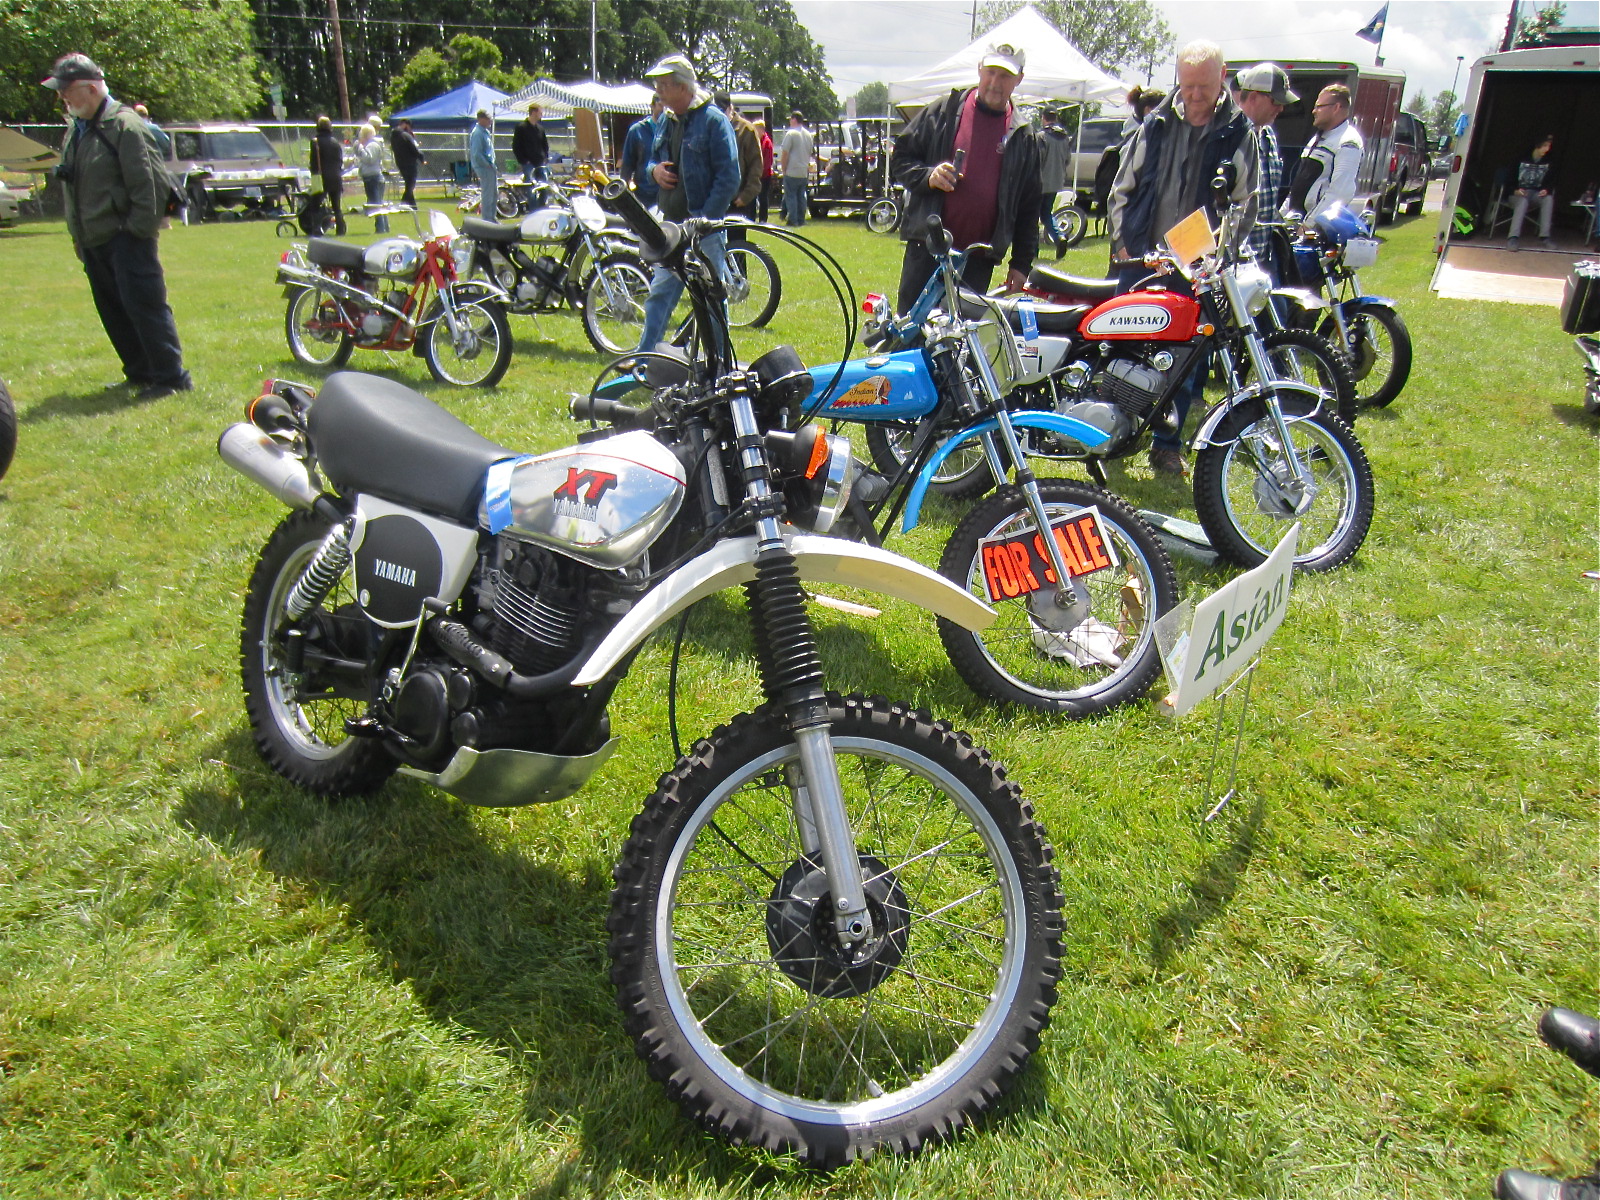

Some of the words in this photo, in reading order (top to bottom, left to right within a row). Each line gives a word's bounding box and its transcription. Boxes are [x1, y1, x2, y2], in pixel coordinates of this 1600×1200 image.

[1109, 316, 1165, 326] KAWASAKI
[849, 386, 874, 396] Indian
[553, 467, 618, 508] XT
[552, 498, 598, 522] YAMAHA
[374, 558, 417, 588] YAMAHA
[983, 541, 1040, 600] FOR
[1033, 517, 1110, 583] SALE
[1193, 573, 1285, 682] Asian
[853, 1113, 920, 1142] PIRELL
